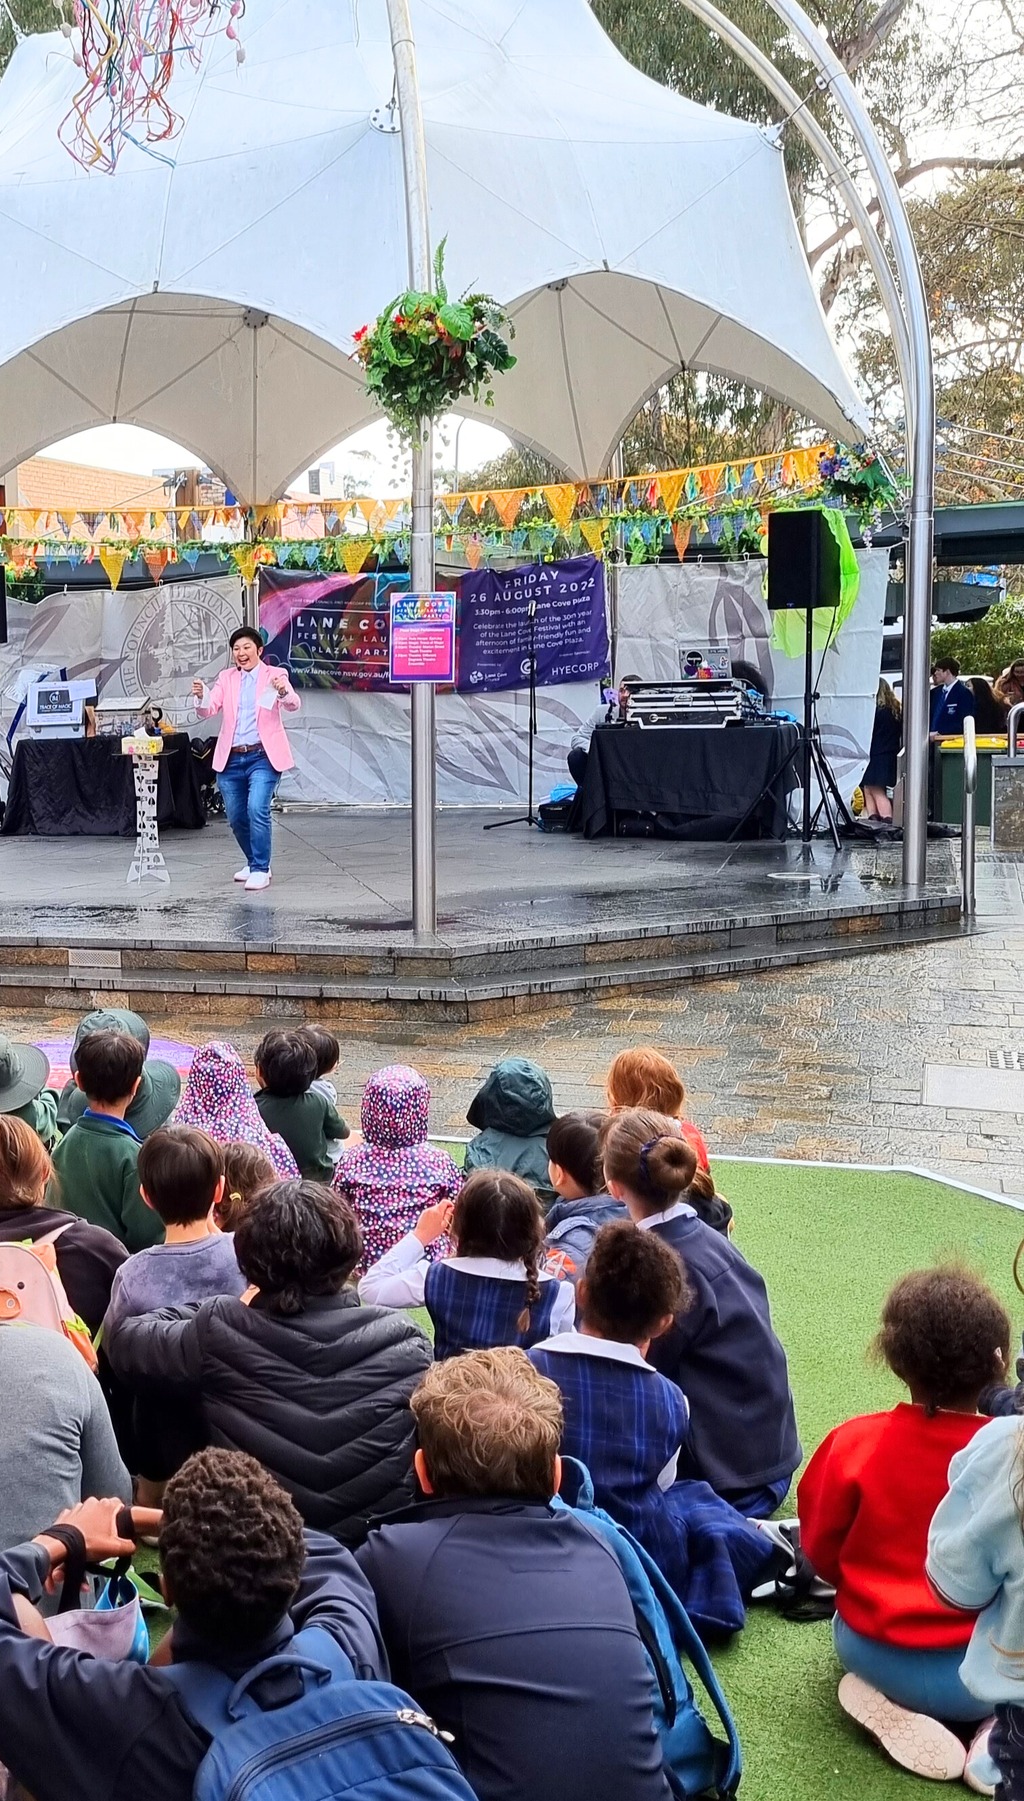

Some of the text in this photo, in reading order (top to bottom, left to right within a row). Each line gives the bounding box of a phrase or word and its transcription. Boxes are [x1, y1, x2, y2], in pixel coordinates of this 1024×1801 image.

[505, 570, 559, 589] FRIDAY
[470, 577, 595, 603] 26 AUGUST 2022
[552, 600, 571, 608] Cove
[296, 616, 386, 630] LANE CO
[507, 621, 517, 629] the
[577, 610, 592, 619] year
[297, 632, 354, 641] FESTIVAL
[475, 638, 508, 647] afternoon
[509, 637, 517, 645] of
[565, 628, 577, 637] fun
[578, 627, 591, 635] and
[480, 630, 487, 638] of
[488, 629, 500, 637] the
[501, 629, 516, 637] Lane
[534, 624, 561, 632] Festival
[311, 646, 348, 655] PLAZA
[356, 648, 389, 656] PART
[546, 640, 563, 649] Cove
[551, 662, 599, 676] HYECORP
